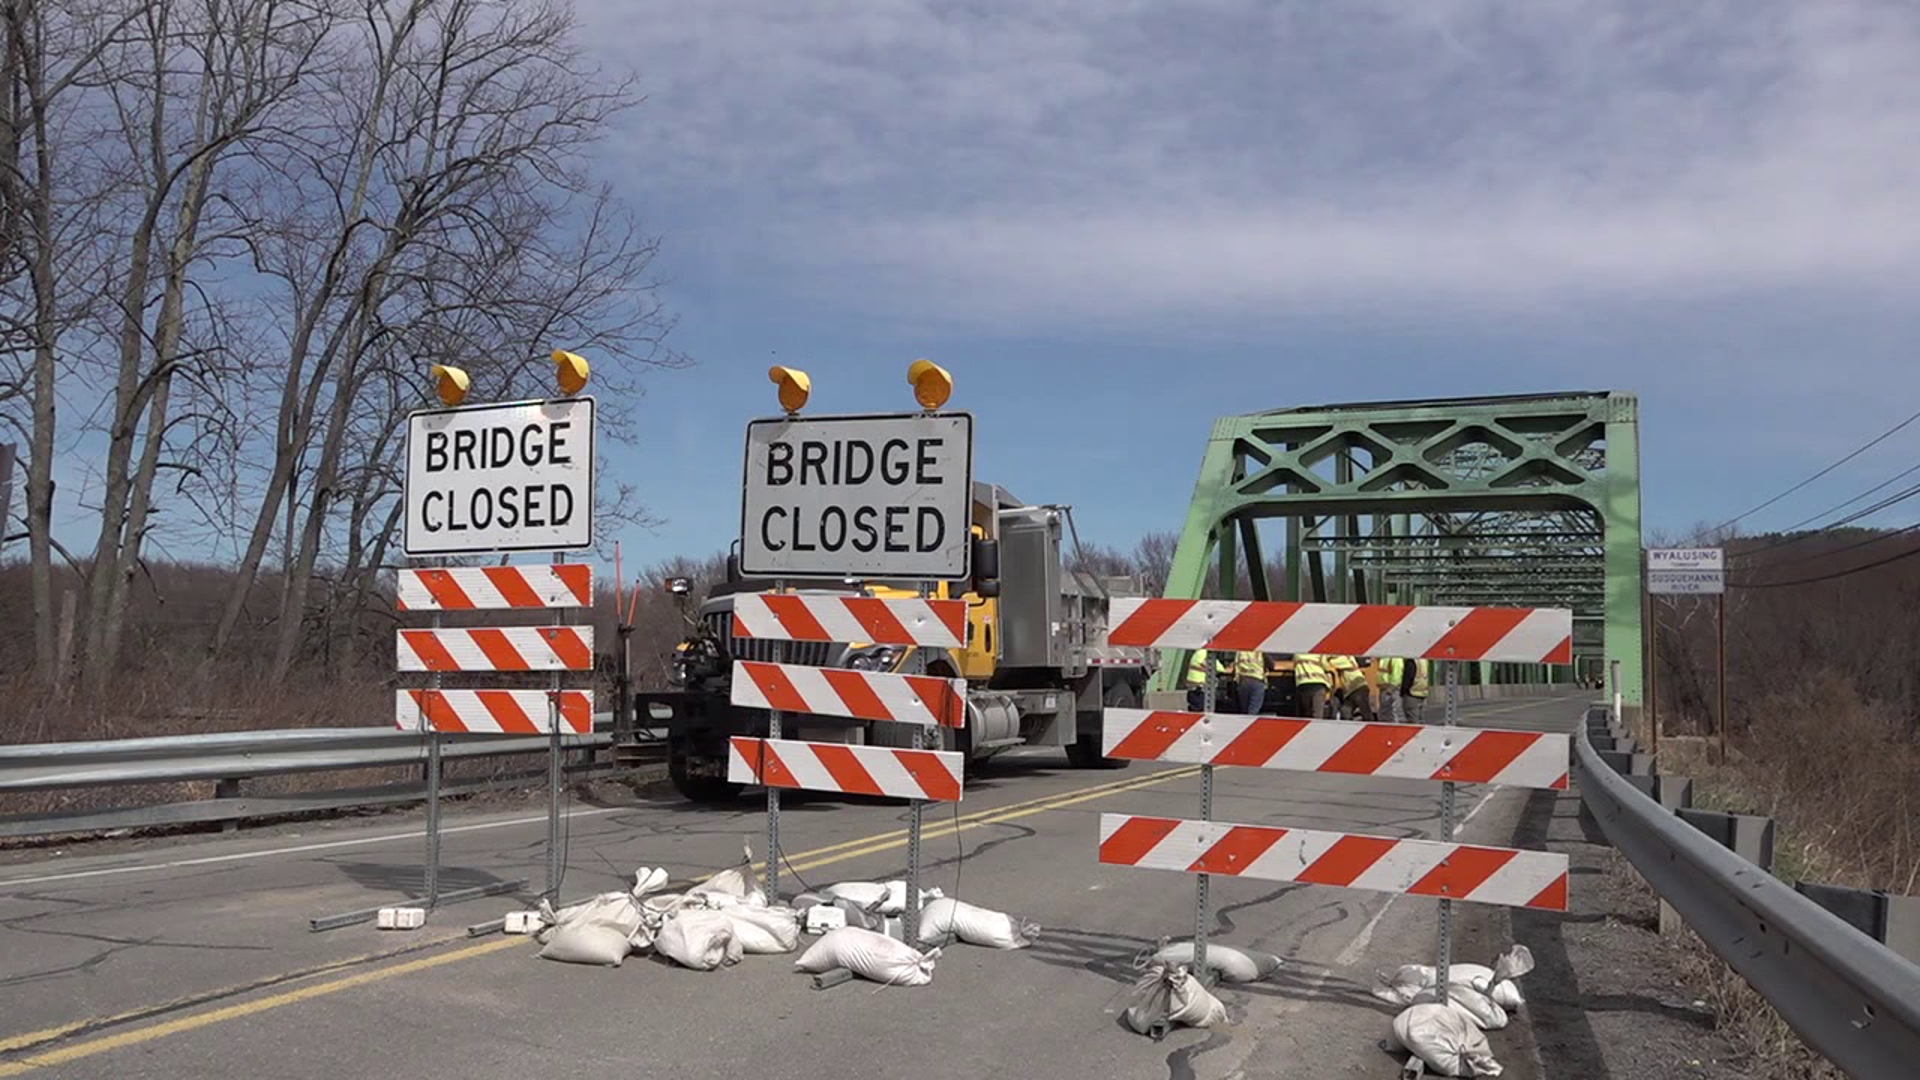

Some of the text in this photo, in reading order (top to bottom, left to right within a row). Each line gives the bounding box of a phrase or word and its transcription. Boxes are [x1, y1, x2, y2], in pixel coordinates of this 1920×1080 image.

[426, 422, 572, 472] BRIDGE
[766, 438, 943, 485] BRIDGE
[422, 484, 573, 532] CLOSED
[761, 505, 945, 552] CLOSED
[1653, 551, 1717, 560] WYALUSING
